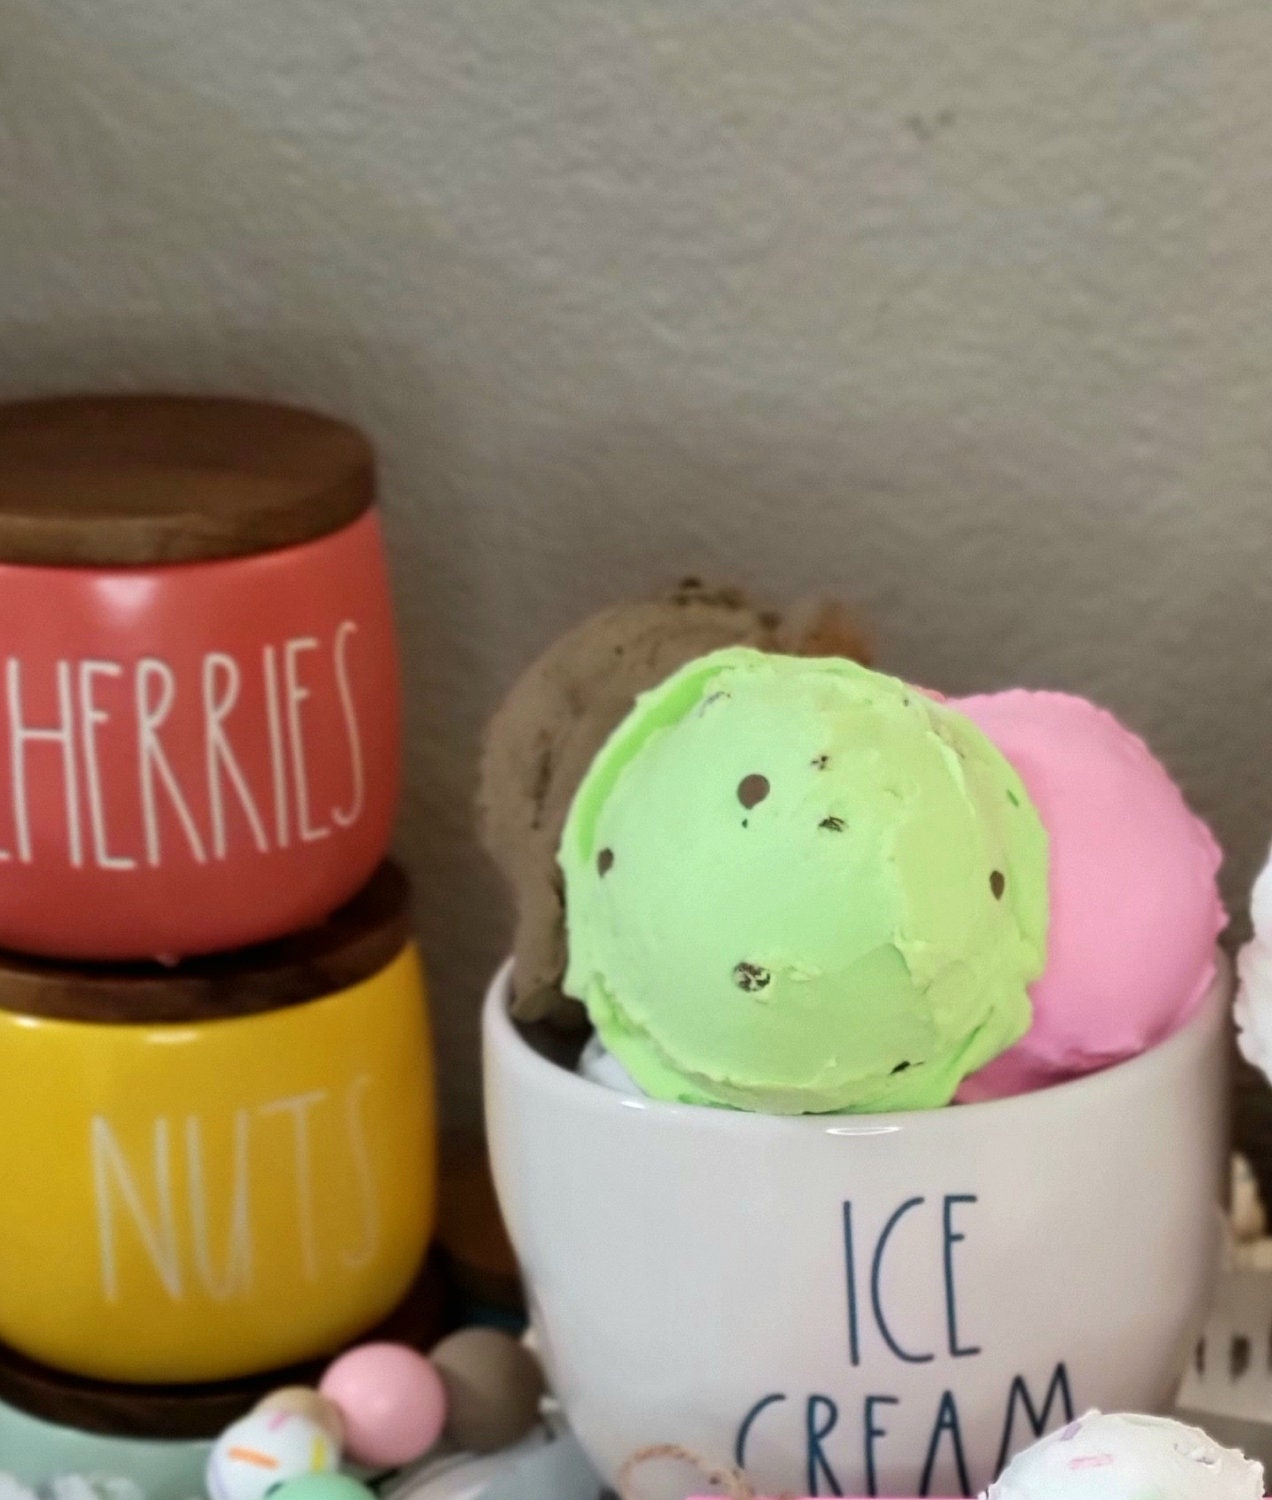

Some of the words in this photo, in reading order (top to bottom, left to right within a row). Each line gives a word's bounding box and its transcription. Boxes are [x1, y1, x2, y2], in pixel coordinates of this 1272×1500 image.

[0, 619, 365, 869] HERRIES
[90, 1072, 381, 1303] NUTS
[843, 1194, 981, 1367] ICE
